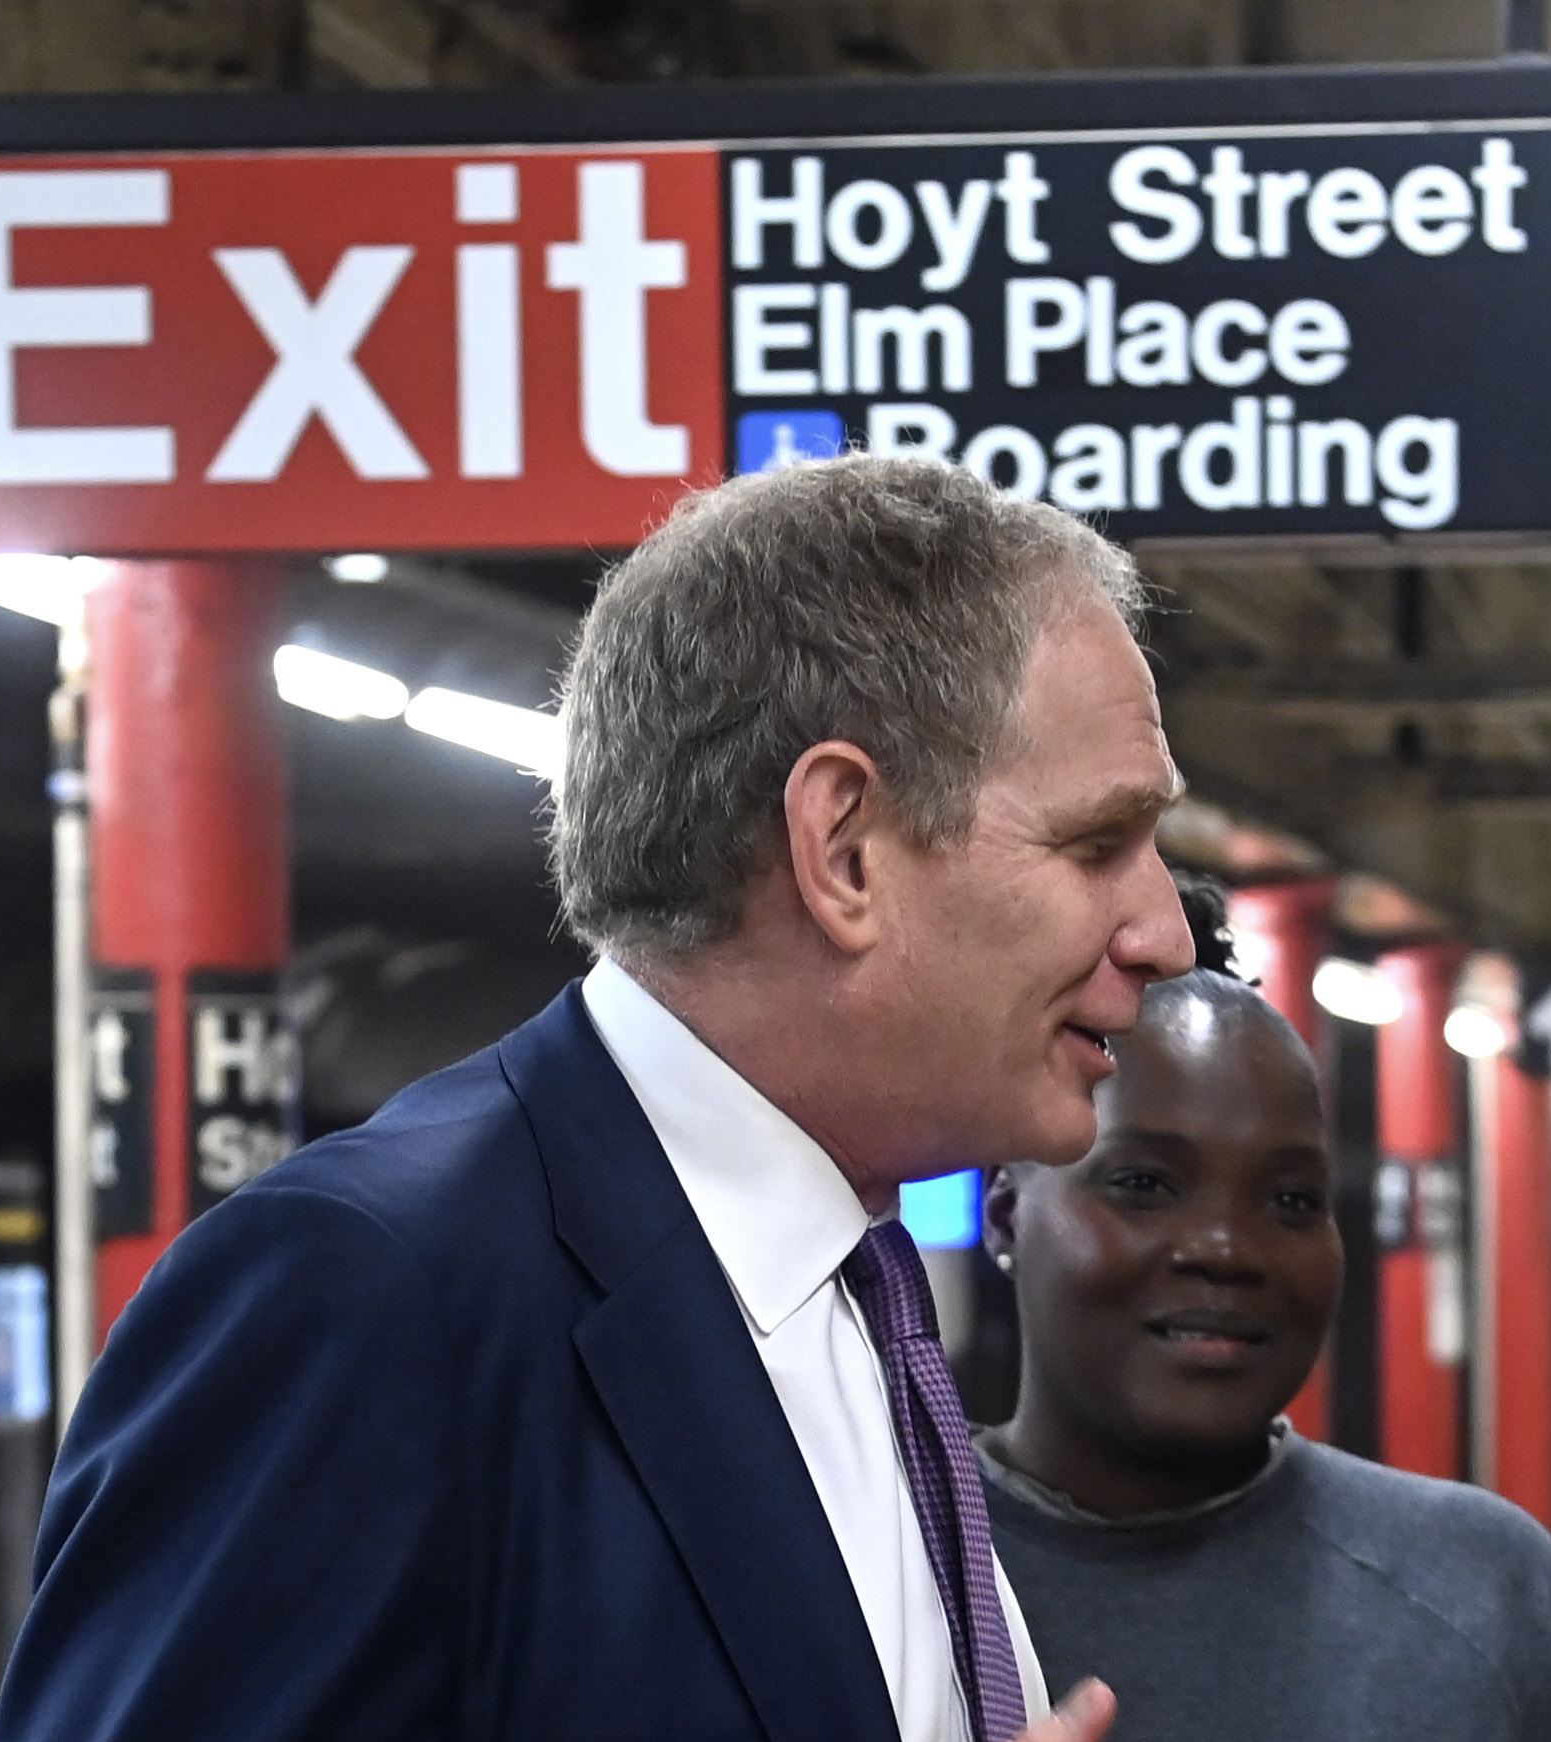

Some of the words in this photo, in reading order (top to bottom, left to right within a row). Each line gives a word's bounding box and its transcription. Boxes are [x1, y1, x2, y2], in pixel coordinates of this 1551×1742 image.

[729, 149, 1052, 293] Hoyt
[1107, 136, 1530, 266] Street
[730, 280, 974, 397] Elm
[1002, 275, 1350, 389] Place
